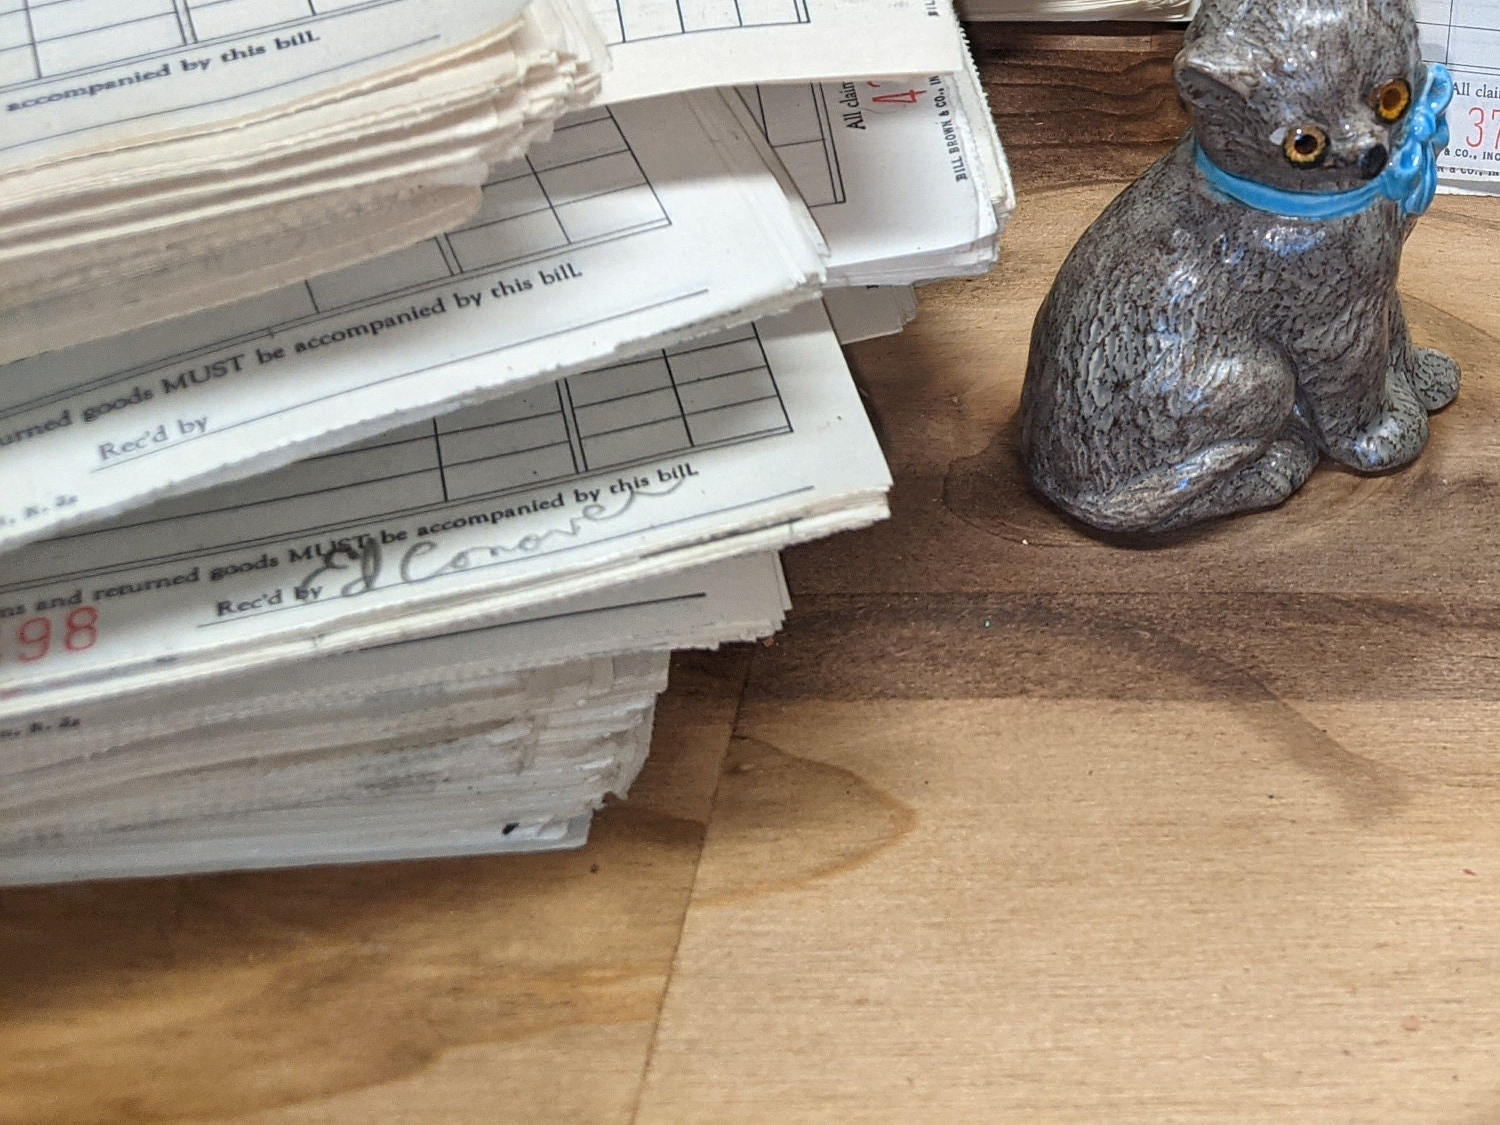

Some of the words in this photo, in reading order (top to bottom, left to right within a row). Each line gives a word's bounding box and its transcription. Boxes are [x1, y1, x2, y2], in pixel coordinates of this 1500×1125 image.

[6, 63, 172, 112] accompanied
[181, 55, 212, 72] by
[221, 43, 267, 64] this
[1451, 82, 1470, 97] All
[842, 111, 866, 130] All
[941, 119, 960, 155] BROWN
[951, 155, 968, 182] BILL
[82, 386, 155, 424] goods
[161, 355, 247, 394] MUST
[256, 342, 286, 365] be
[295, 298, 446, 354] accompanied
[453, 288, 484, 311] by
[491, 276, 534, 299] this
[98, 426, 171, 461] Rec'd
[178, 414, 208, 436] by
[36, 588, 83, 611] and
[93, 568, 200, 602] returned
[210, 553, 279, 582] goods
[287, 532, 370, 564] MUST
[381, 525, 408, 546] be
[416, 492, 566, 538] accompanied
[574, 485, 601, 504] by
[609, 476, 651, 497] this
[215, 590, 283, 617] Rec'd
[294, 585, 324, 602] by
